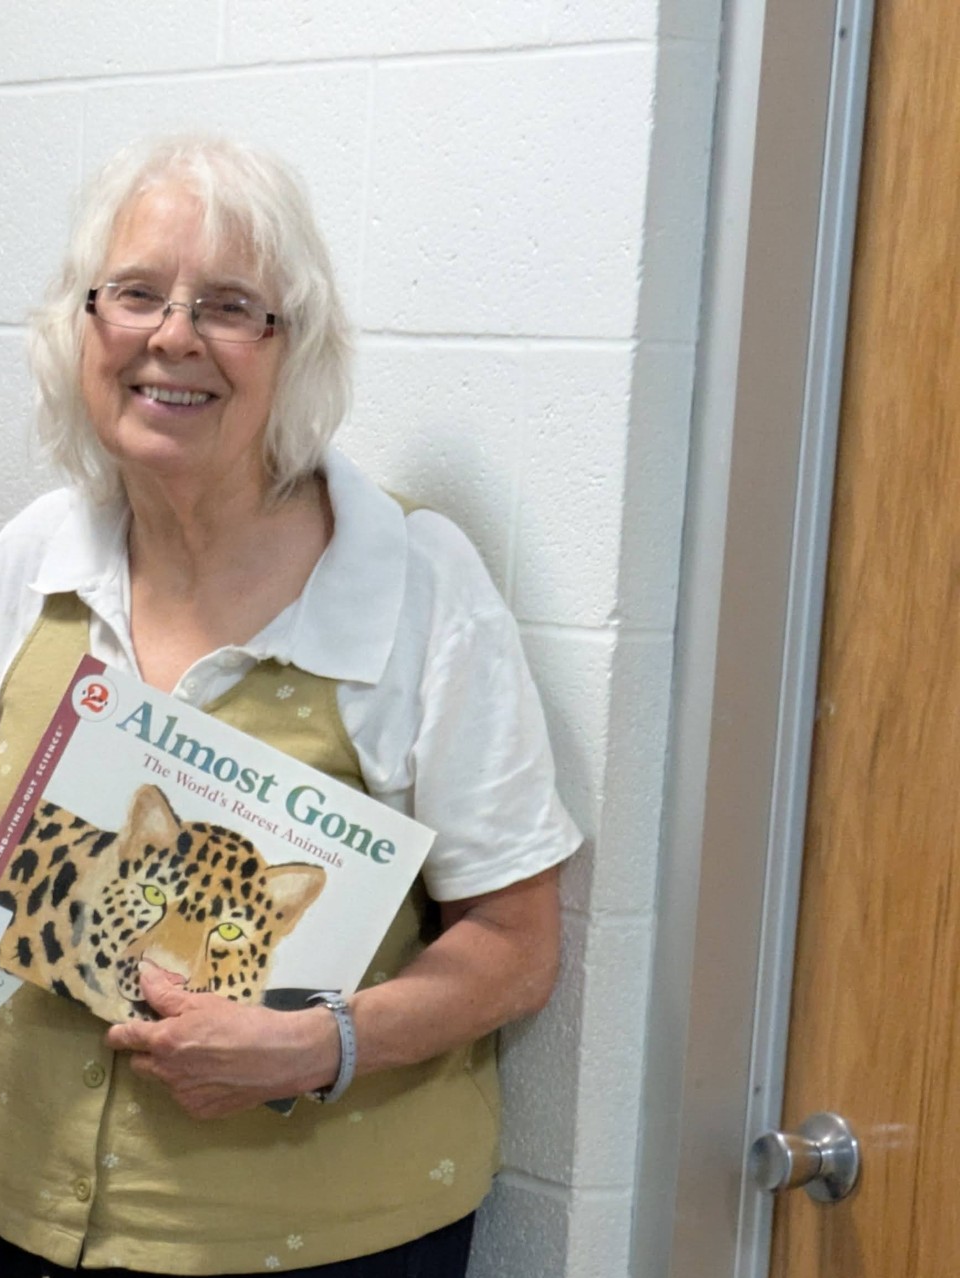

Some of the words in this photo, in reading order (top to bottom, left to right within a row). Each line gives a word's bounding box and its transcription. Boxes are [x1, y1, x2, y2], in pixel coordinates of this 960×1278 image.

[80, 683, 110, 714] 2
[116, 700, 279, 803] Almost
[285, 784, 396, 865] Gone
[142, 753, 171, 778] The
[175, 769, 229, 809] World's
[231, 801, 279, 835] Rarest
[280, 827, 345, 868] Animals
